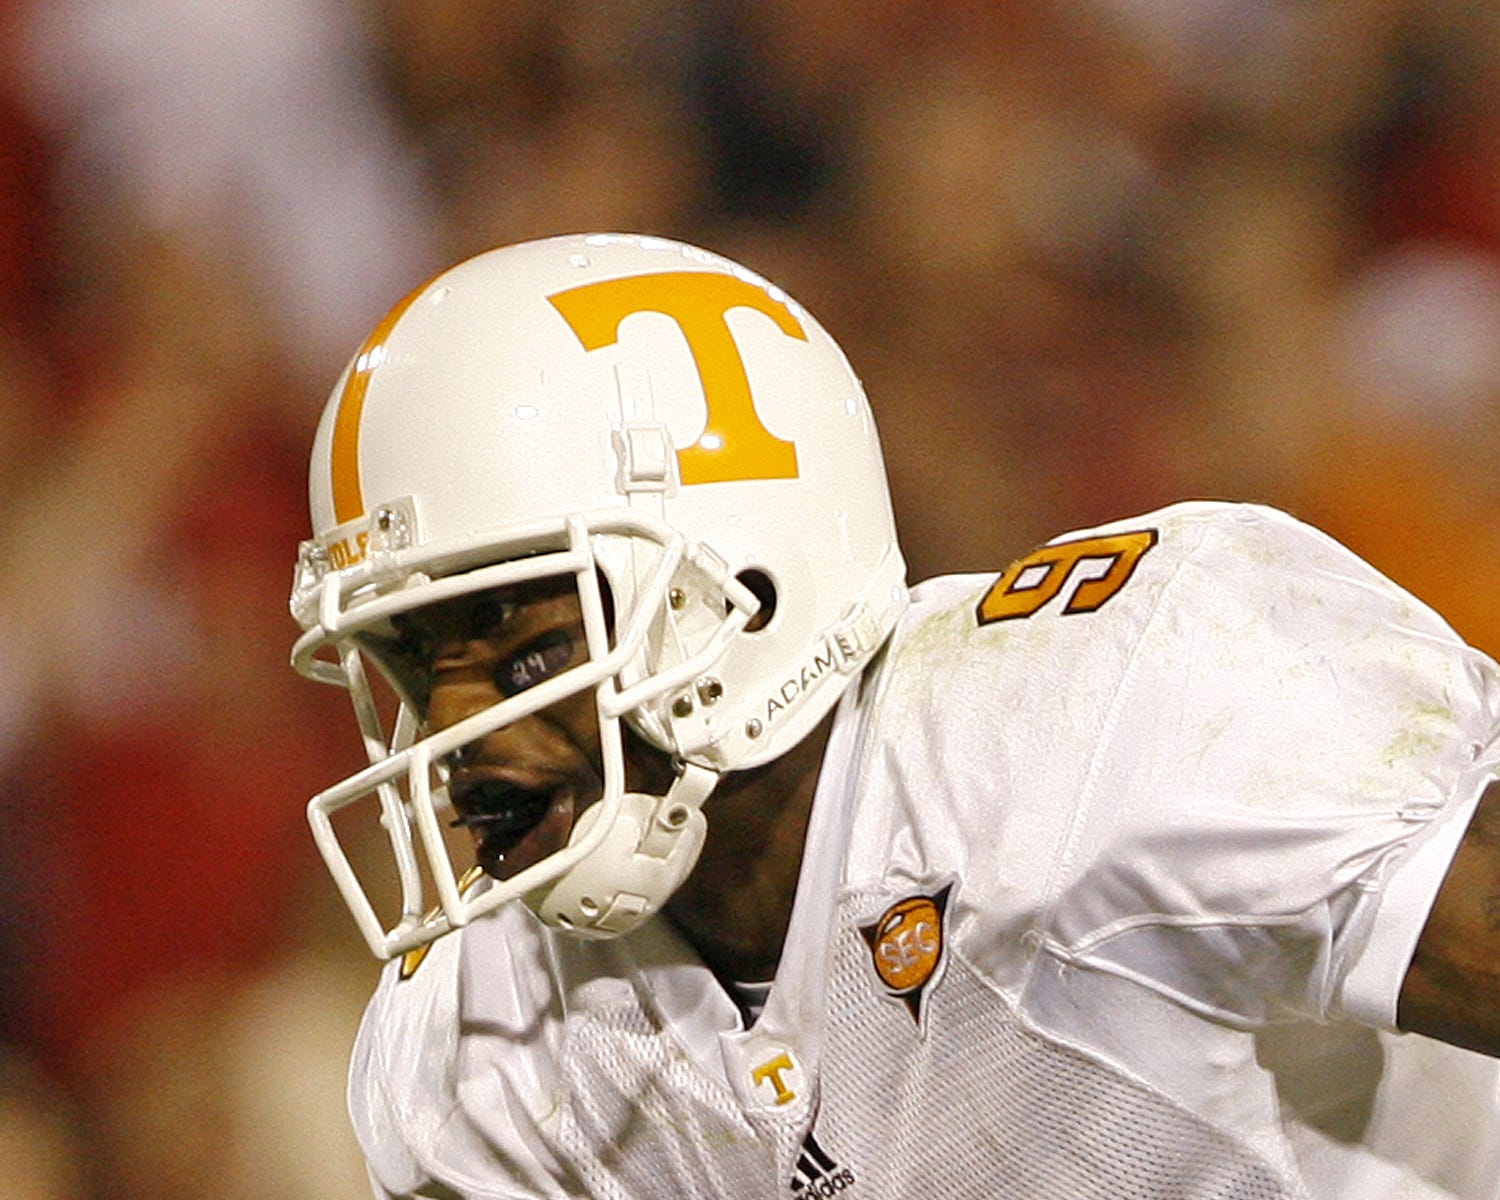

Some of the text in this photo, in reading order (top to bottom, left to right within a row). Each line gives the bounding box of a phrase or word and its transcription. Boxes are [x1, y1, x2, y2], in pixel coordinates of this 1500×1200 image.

[545, 271, 809, 486] T
[975, 528, 1159, 627] 9
[880, 920, 937, 974] SEC
[752, 1052, 797, 1106] T
